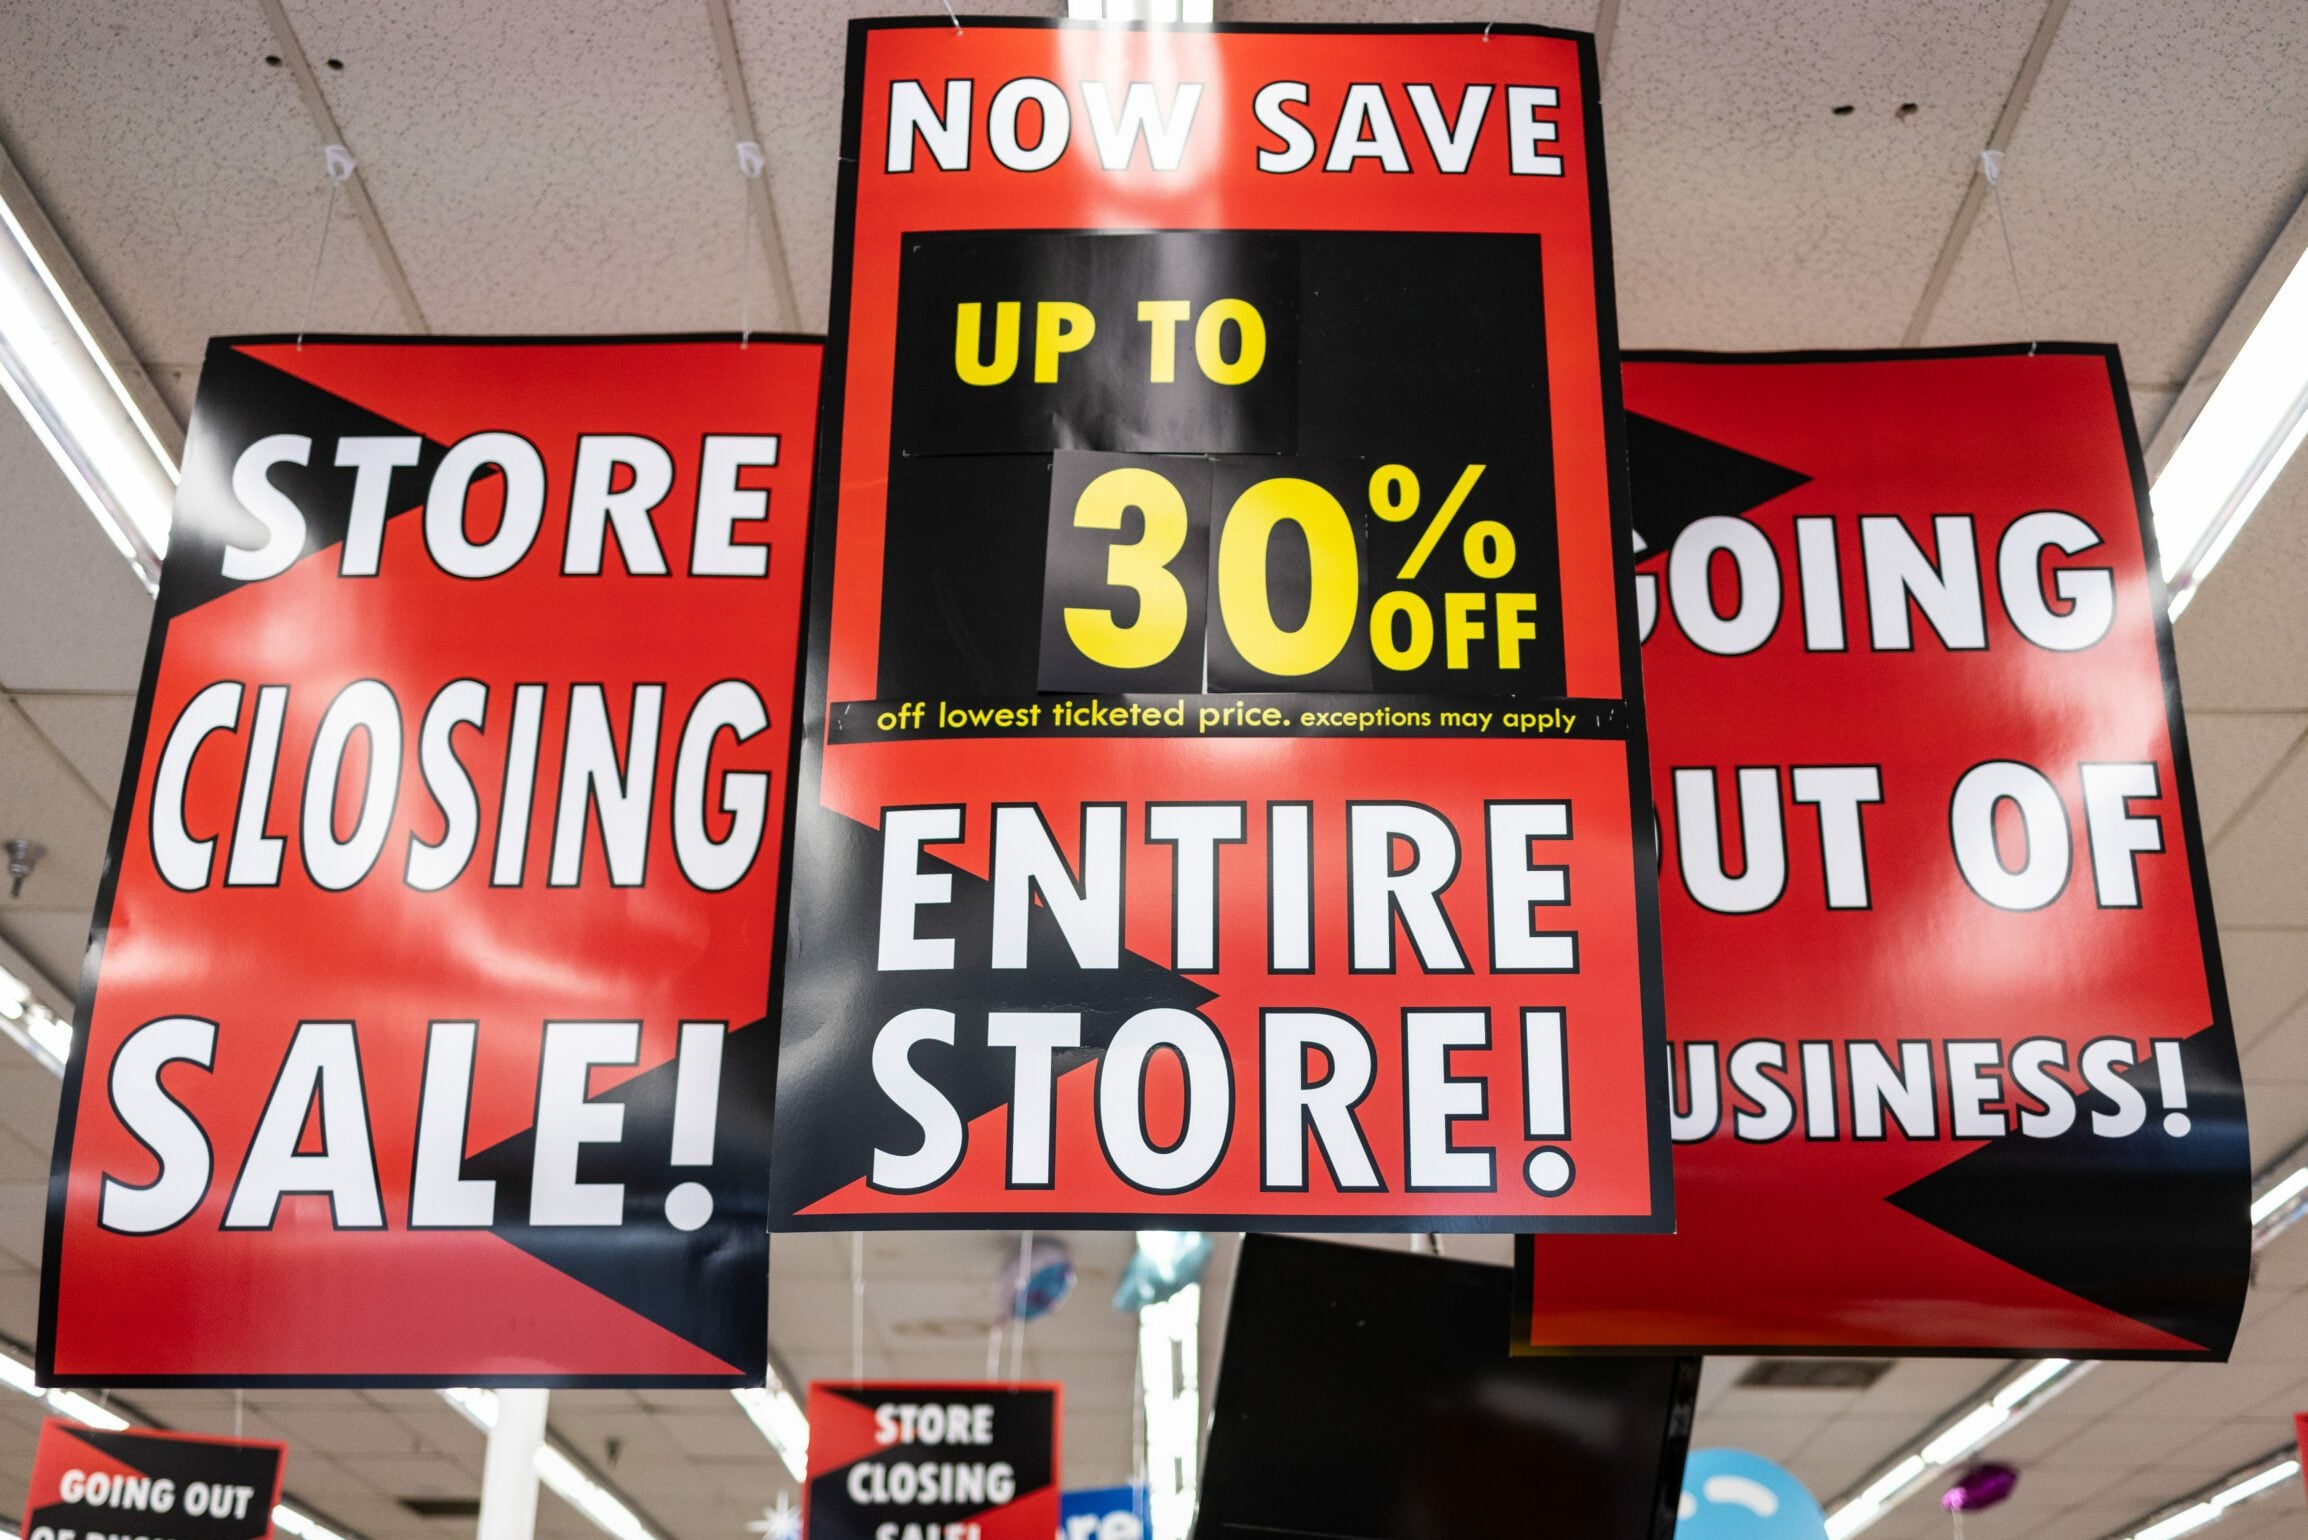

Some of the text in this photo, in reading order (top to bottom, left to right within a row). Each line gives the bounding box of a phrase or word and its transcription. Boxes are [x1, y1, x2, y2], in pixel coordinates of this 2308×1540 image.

[886, 77, 1565, 177] NOW SAVE
[954, 298, 1268, 387] UP TO
[220, 430, 781, 580] STORE
[1369, 590, 1538, 671] OFF
[1632, 512, 2117, 656] OING
[876, 699, 1577, 733] off lowest ticketed price. exceptions may apply
[148, 678, 773, 893] CLOSING
[877, 800, 1580, 975] ENTIRE
[1654, 759, 2166, 916] UT OF
[97, 1015, 729, 1234] SALE!
[866, 1006, 1577, 1198] STORE!
[1667, 1036, 2193, 1143] USINESS!
[874, 1403, 995, 1446] STORE
[59, 1468, 254, 1520] GOING OUT
[846, 1462, 1016, 1505] CLOSING
[1056, 1510, 1143, 1540] re
